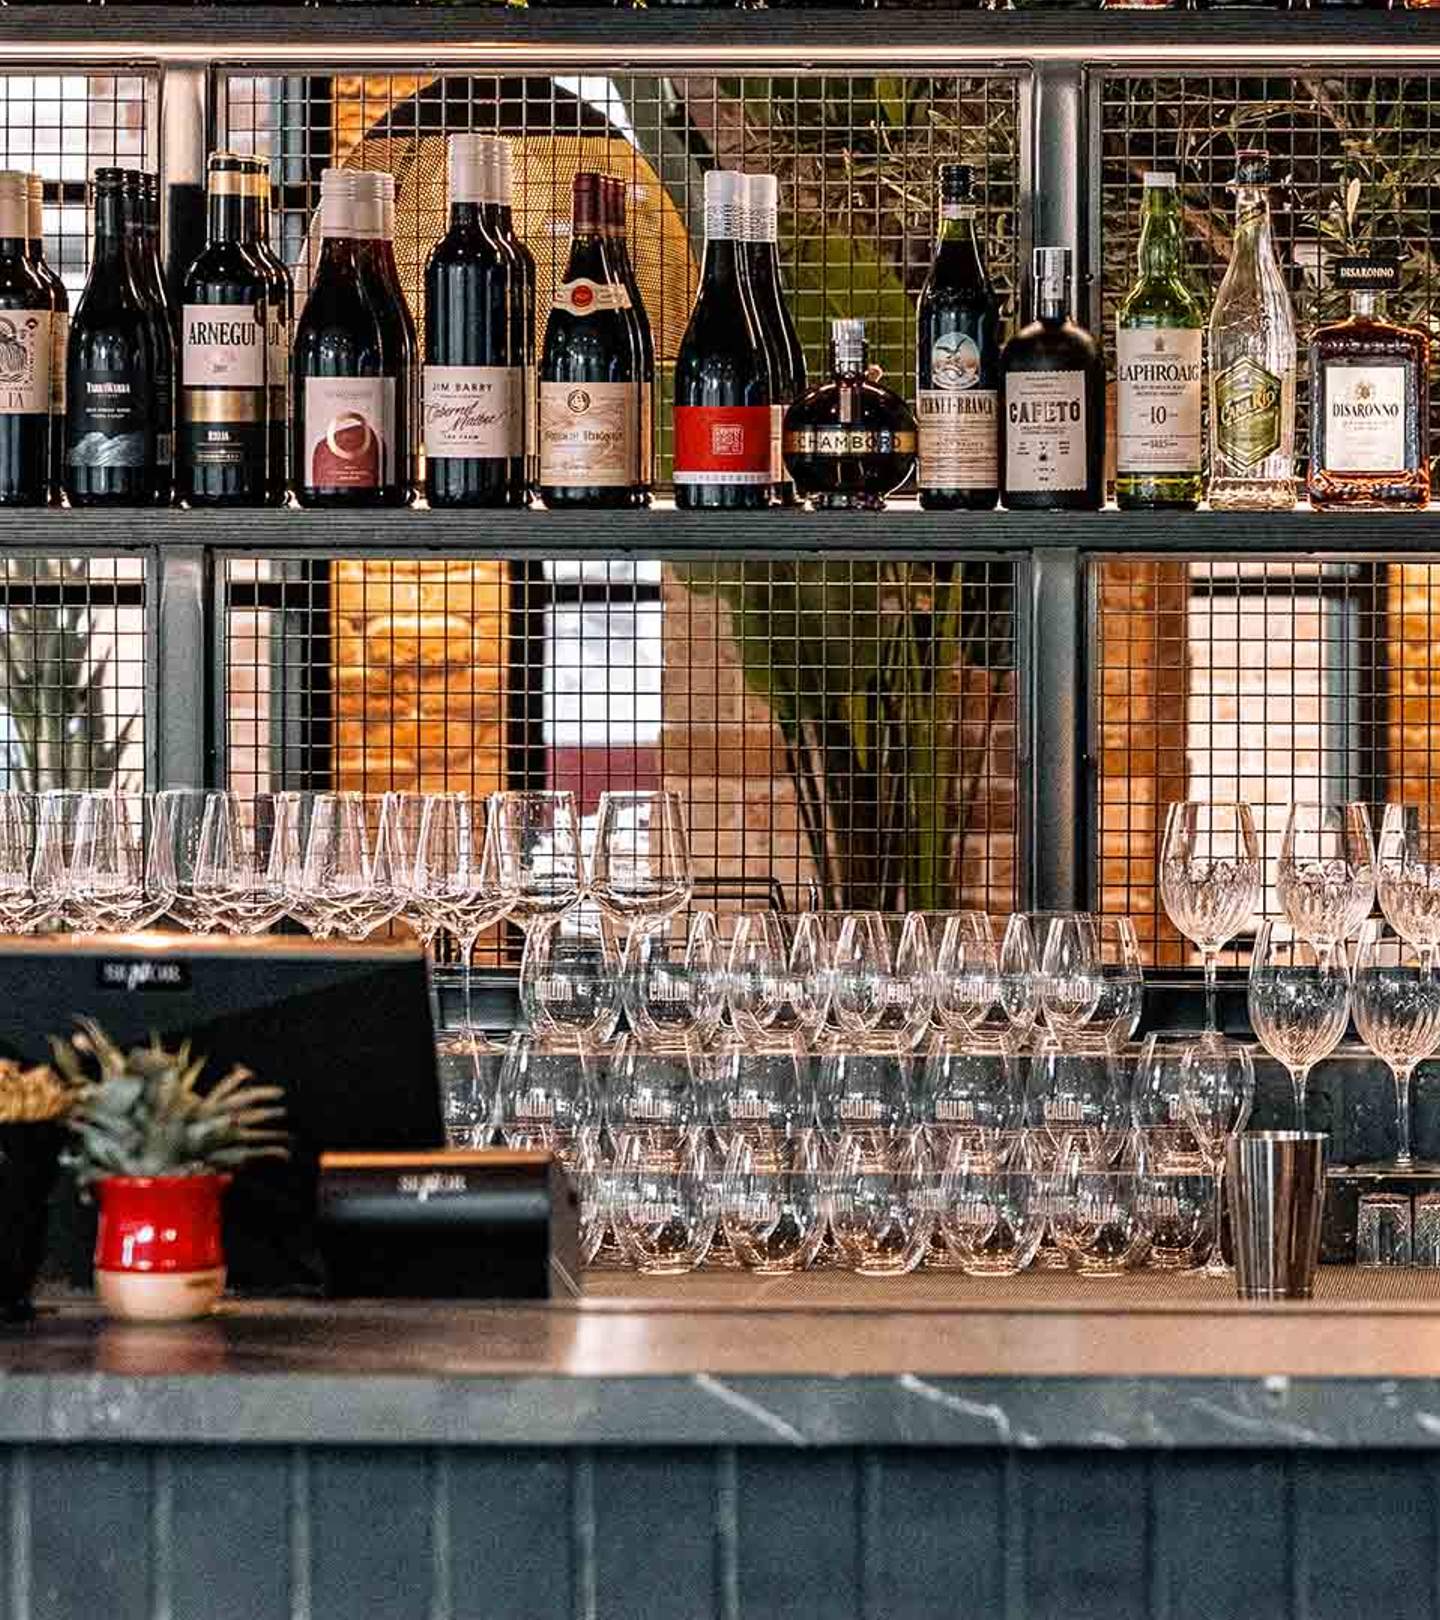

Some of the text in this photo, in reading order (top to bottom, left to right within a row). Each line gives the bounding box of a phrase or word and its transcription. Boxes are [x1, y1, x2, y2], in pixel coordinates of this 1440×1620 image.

[1340, 267, 1395, 278] DISARONNO
[188, 322, 256, 346] ARNEGUI
[1118, 364, 1200, 382] LAPHROAIG
[1150, 405, 1167, 425] 10
[1332, 403, 1400, 418] DISARONNO
[797, 434, 902, 450] CHAMBORD
